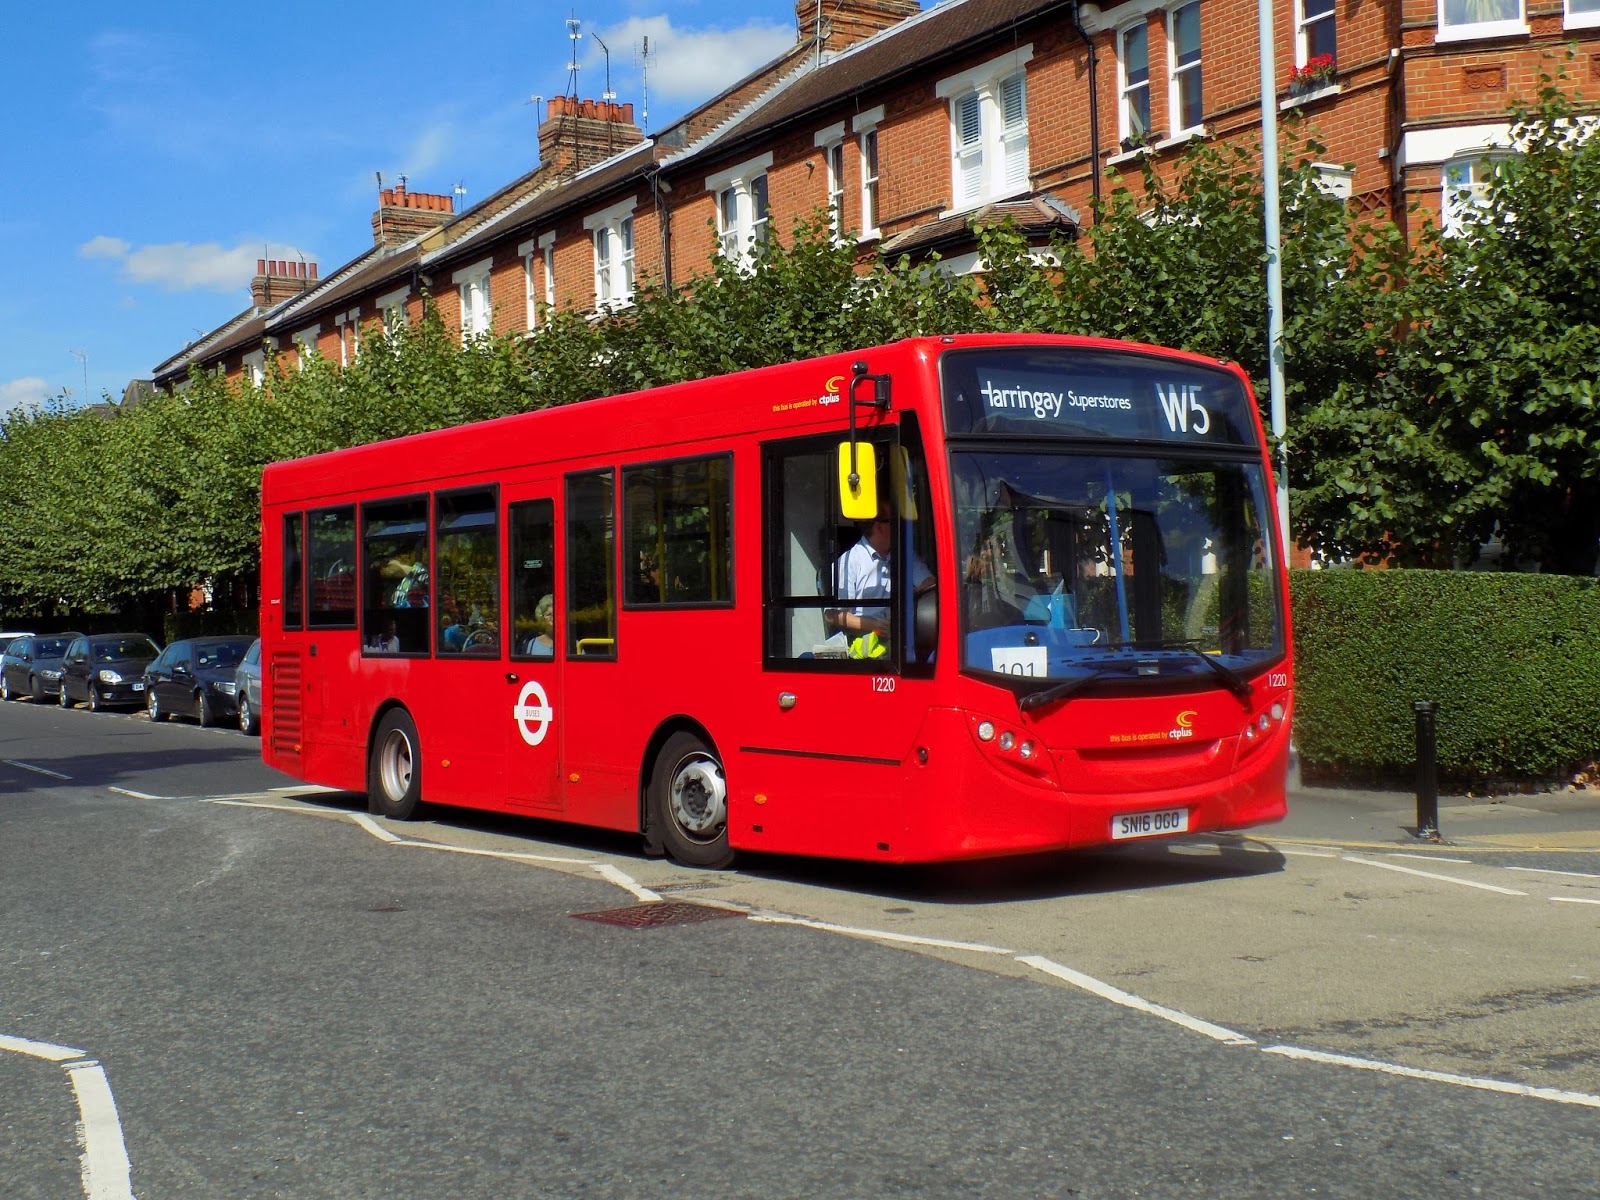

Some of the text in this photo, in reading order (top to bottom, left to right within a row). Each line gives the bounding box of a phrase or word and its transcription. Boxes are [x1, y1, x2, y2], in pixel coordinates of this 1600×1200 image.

[772, 404, 781, 412] this
[781, 403, 789, 411] bus
[793, 399, 812, 409] operated
[818, 392, 840, 406] ctplus
[1067, 390, 1132, 411] Superstores
[1155, 382, 1210, 435] W5
[999, 662, 1034, 677] 101
[872, 677, 896, 692] 1220
[1268, 673, 1287, 687] 1220
[525, 709, 541, 718] BUSES
[1110, 734, 1121, 742] this
[1137, 731, 1161, 741] operated
[1161, 731, 1168, 739] by
[1169, 726, 1193, 740] ctplus
[1121, 811, 1180, 835] SN16 OGO
